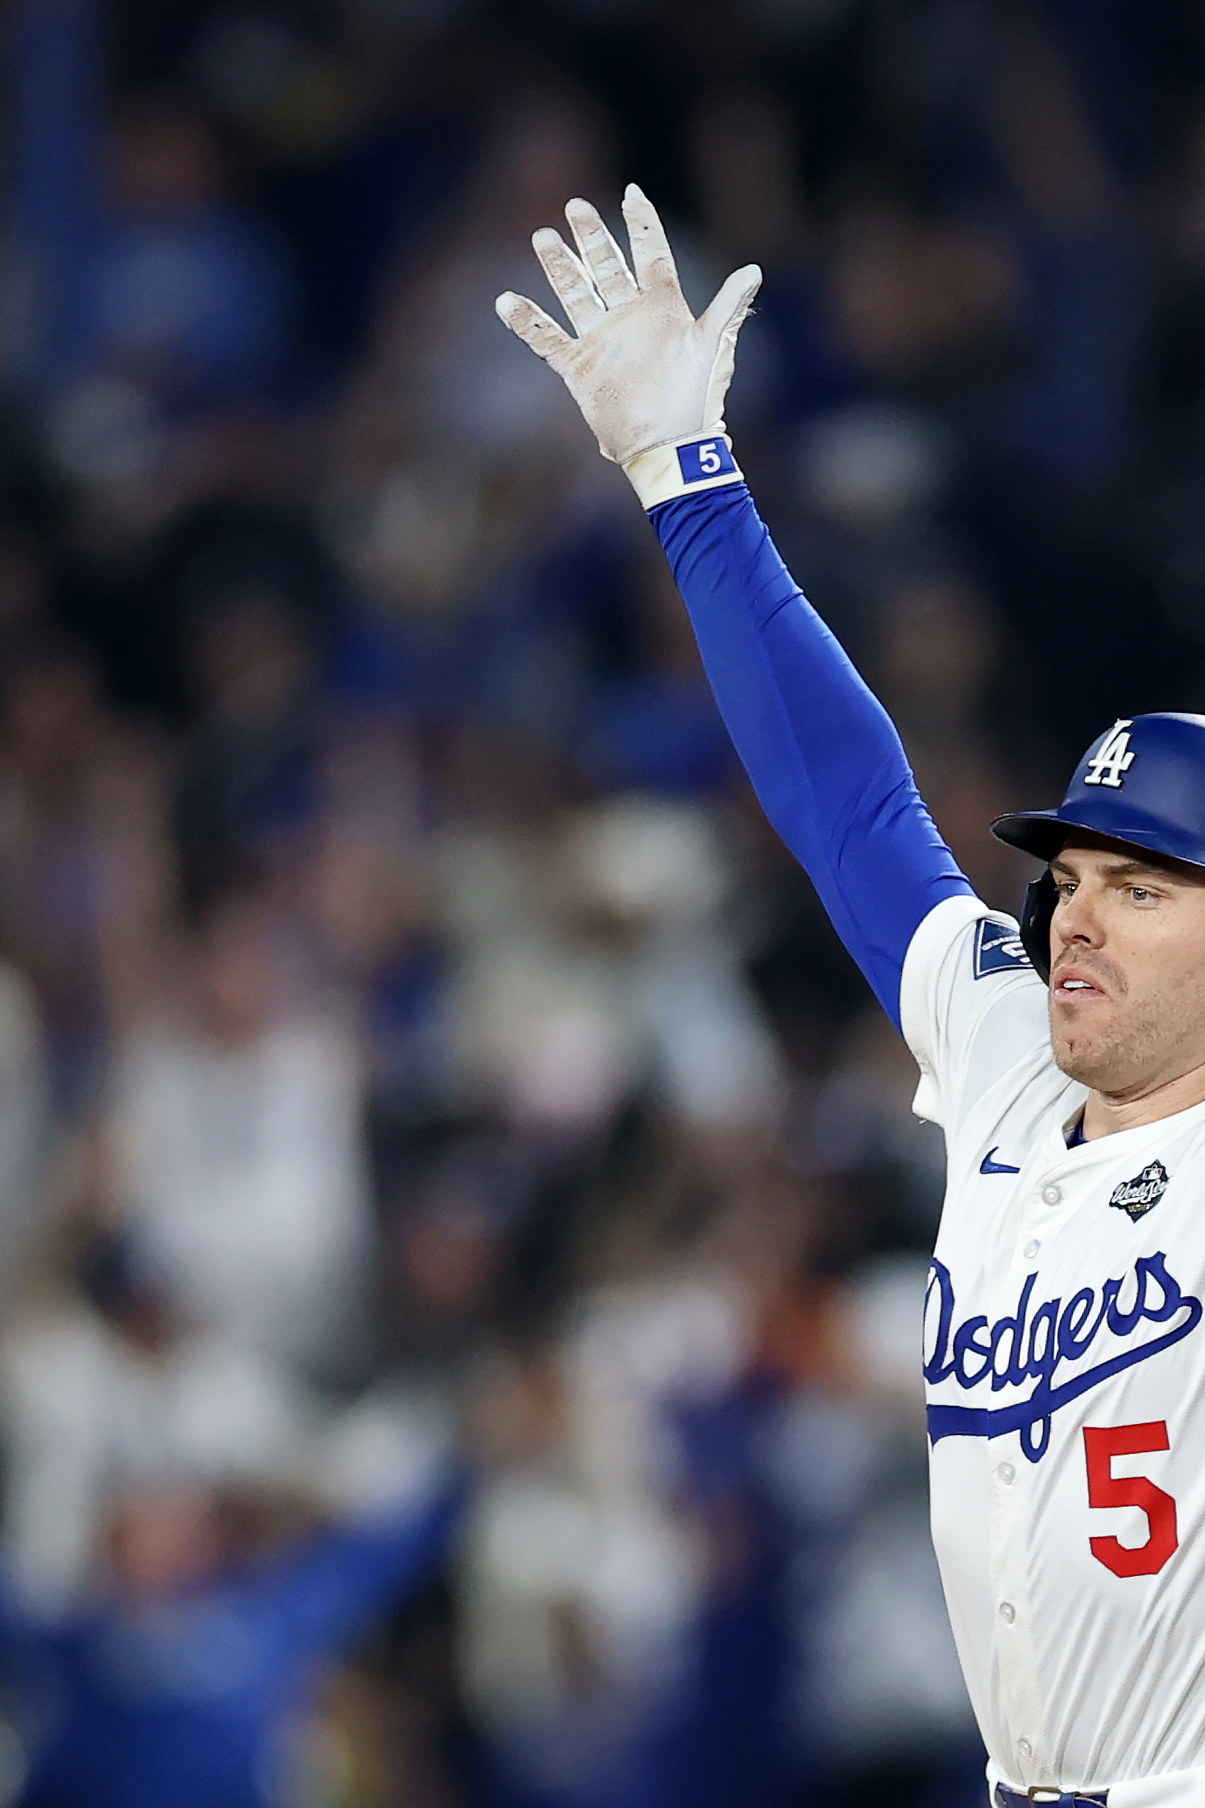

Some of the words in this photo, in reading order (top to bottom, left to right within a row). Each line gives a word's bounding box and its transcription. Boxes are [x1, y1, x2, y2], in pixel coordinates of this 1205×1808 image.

[699, 442, 721, 474] 5
[1084, 718, 1136, 787] LA
[923, 1252, 1203, 1464] Dodgers
[1082, 1420, 1179, 1579] 5
